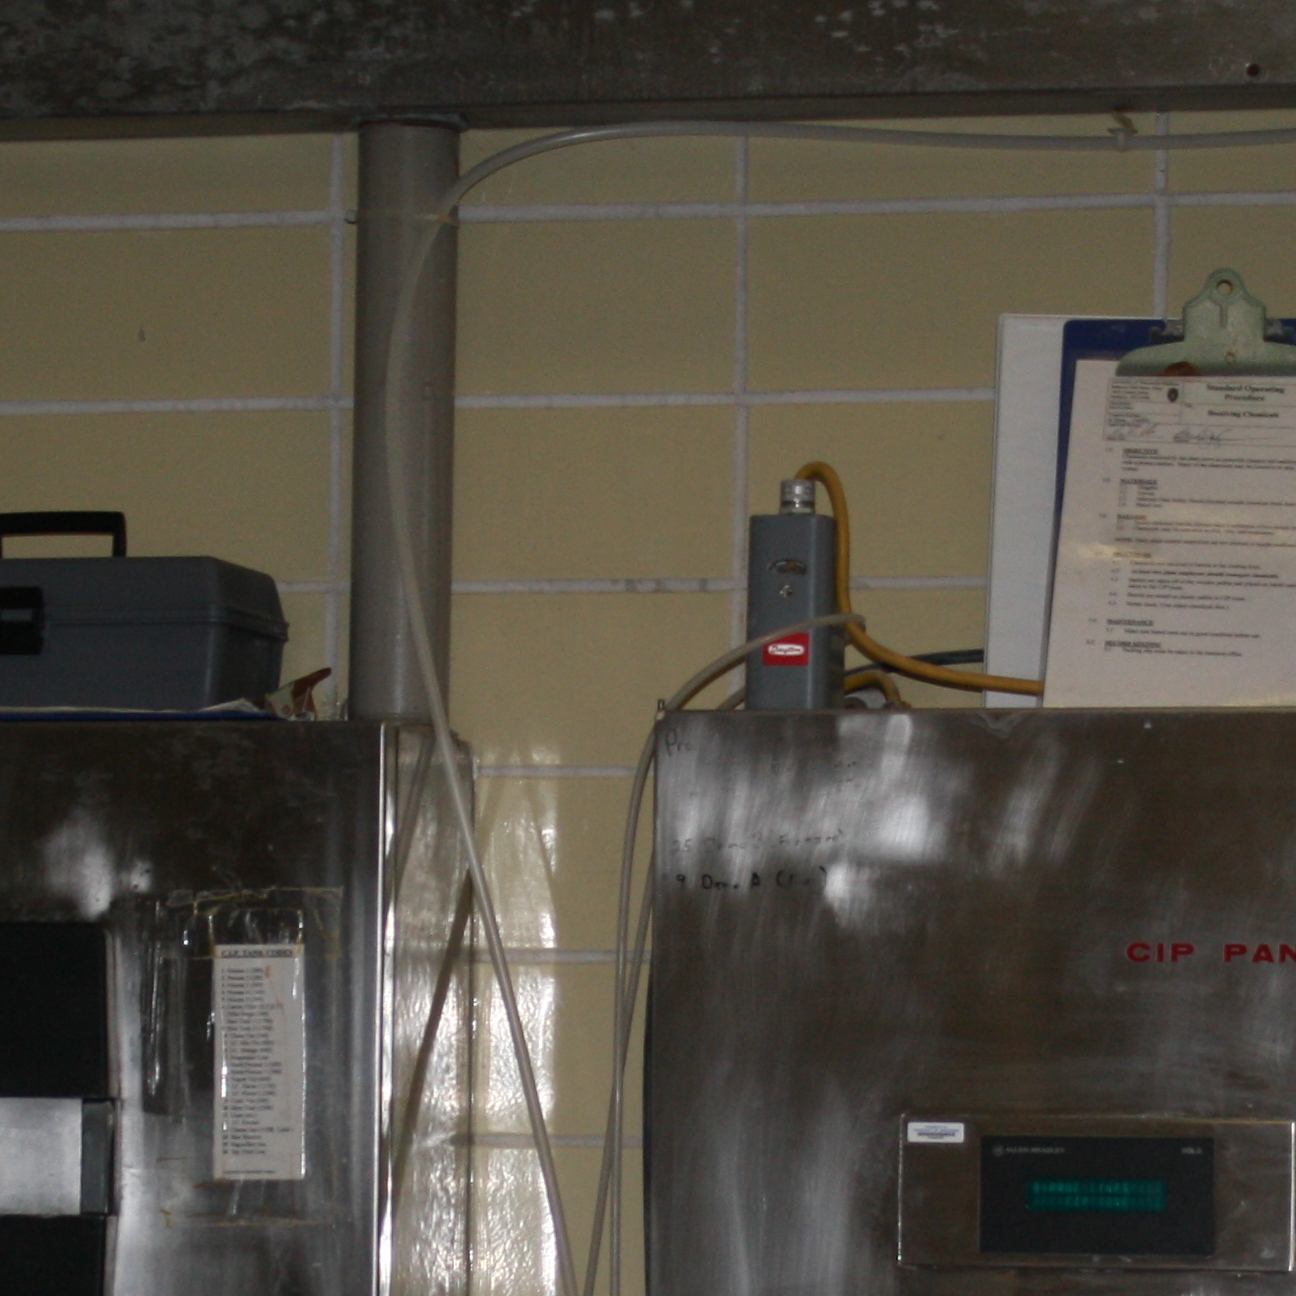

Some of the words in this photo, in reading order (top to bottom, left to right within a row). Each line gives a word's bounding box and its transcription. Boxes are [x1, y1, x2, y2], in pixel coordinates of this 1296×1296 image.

[1207, 383, 1242, 391] Standard
[1244, 385, 1284, 394] Operating
[1224, 393, 1265, 402] Procedure
[1126, 942, 1194, 963] CIP
